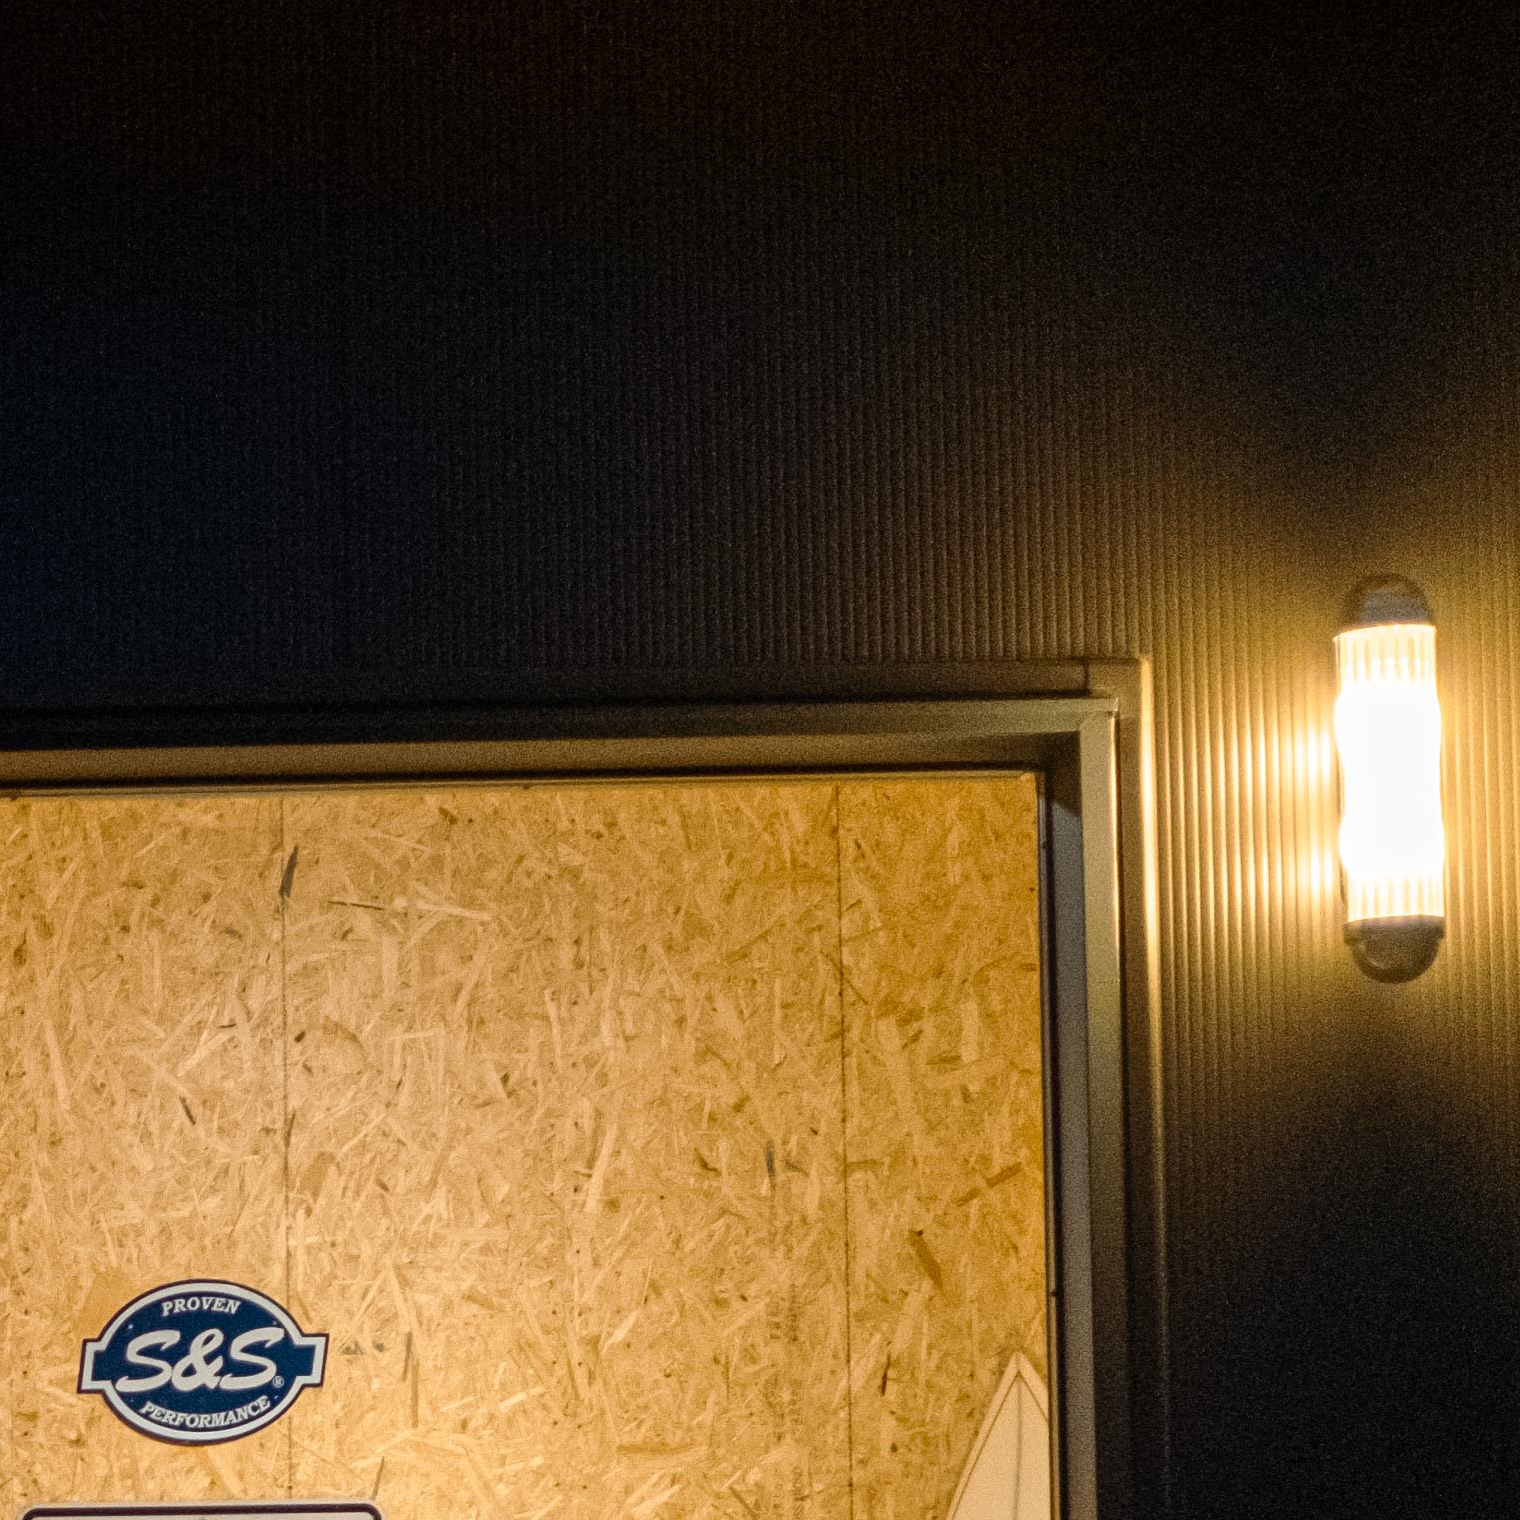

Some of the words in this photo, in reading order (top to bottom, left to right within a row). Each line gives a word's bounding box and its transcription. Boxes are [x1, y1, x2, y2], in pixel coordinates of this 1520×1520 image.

[162, 1297, 241, 1316] PROVEN
[115, 1327, 285, 1392] S&S
[139, 1395, 271, 1428] PERFORMANCE
